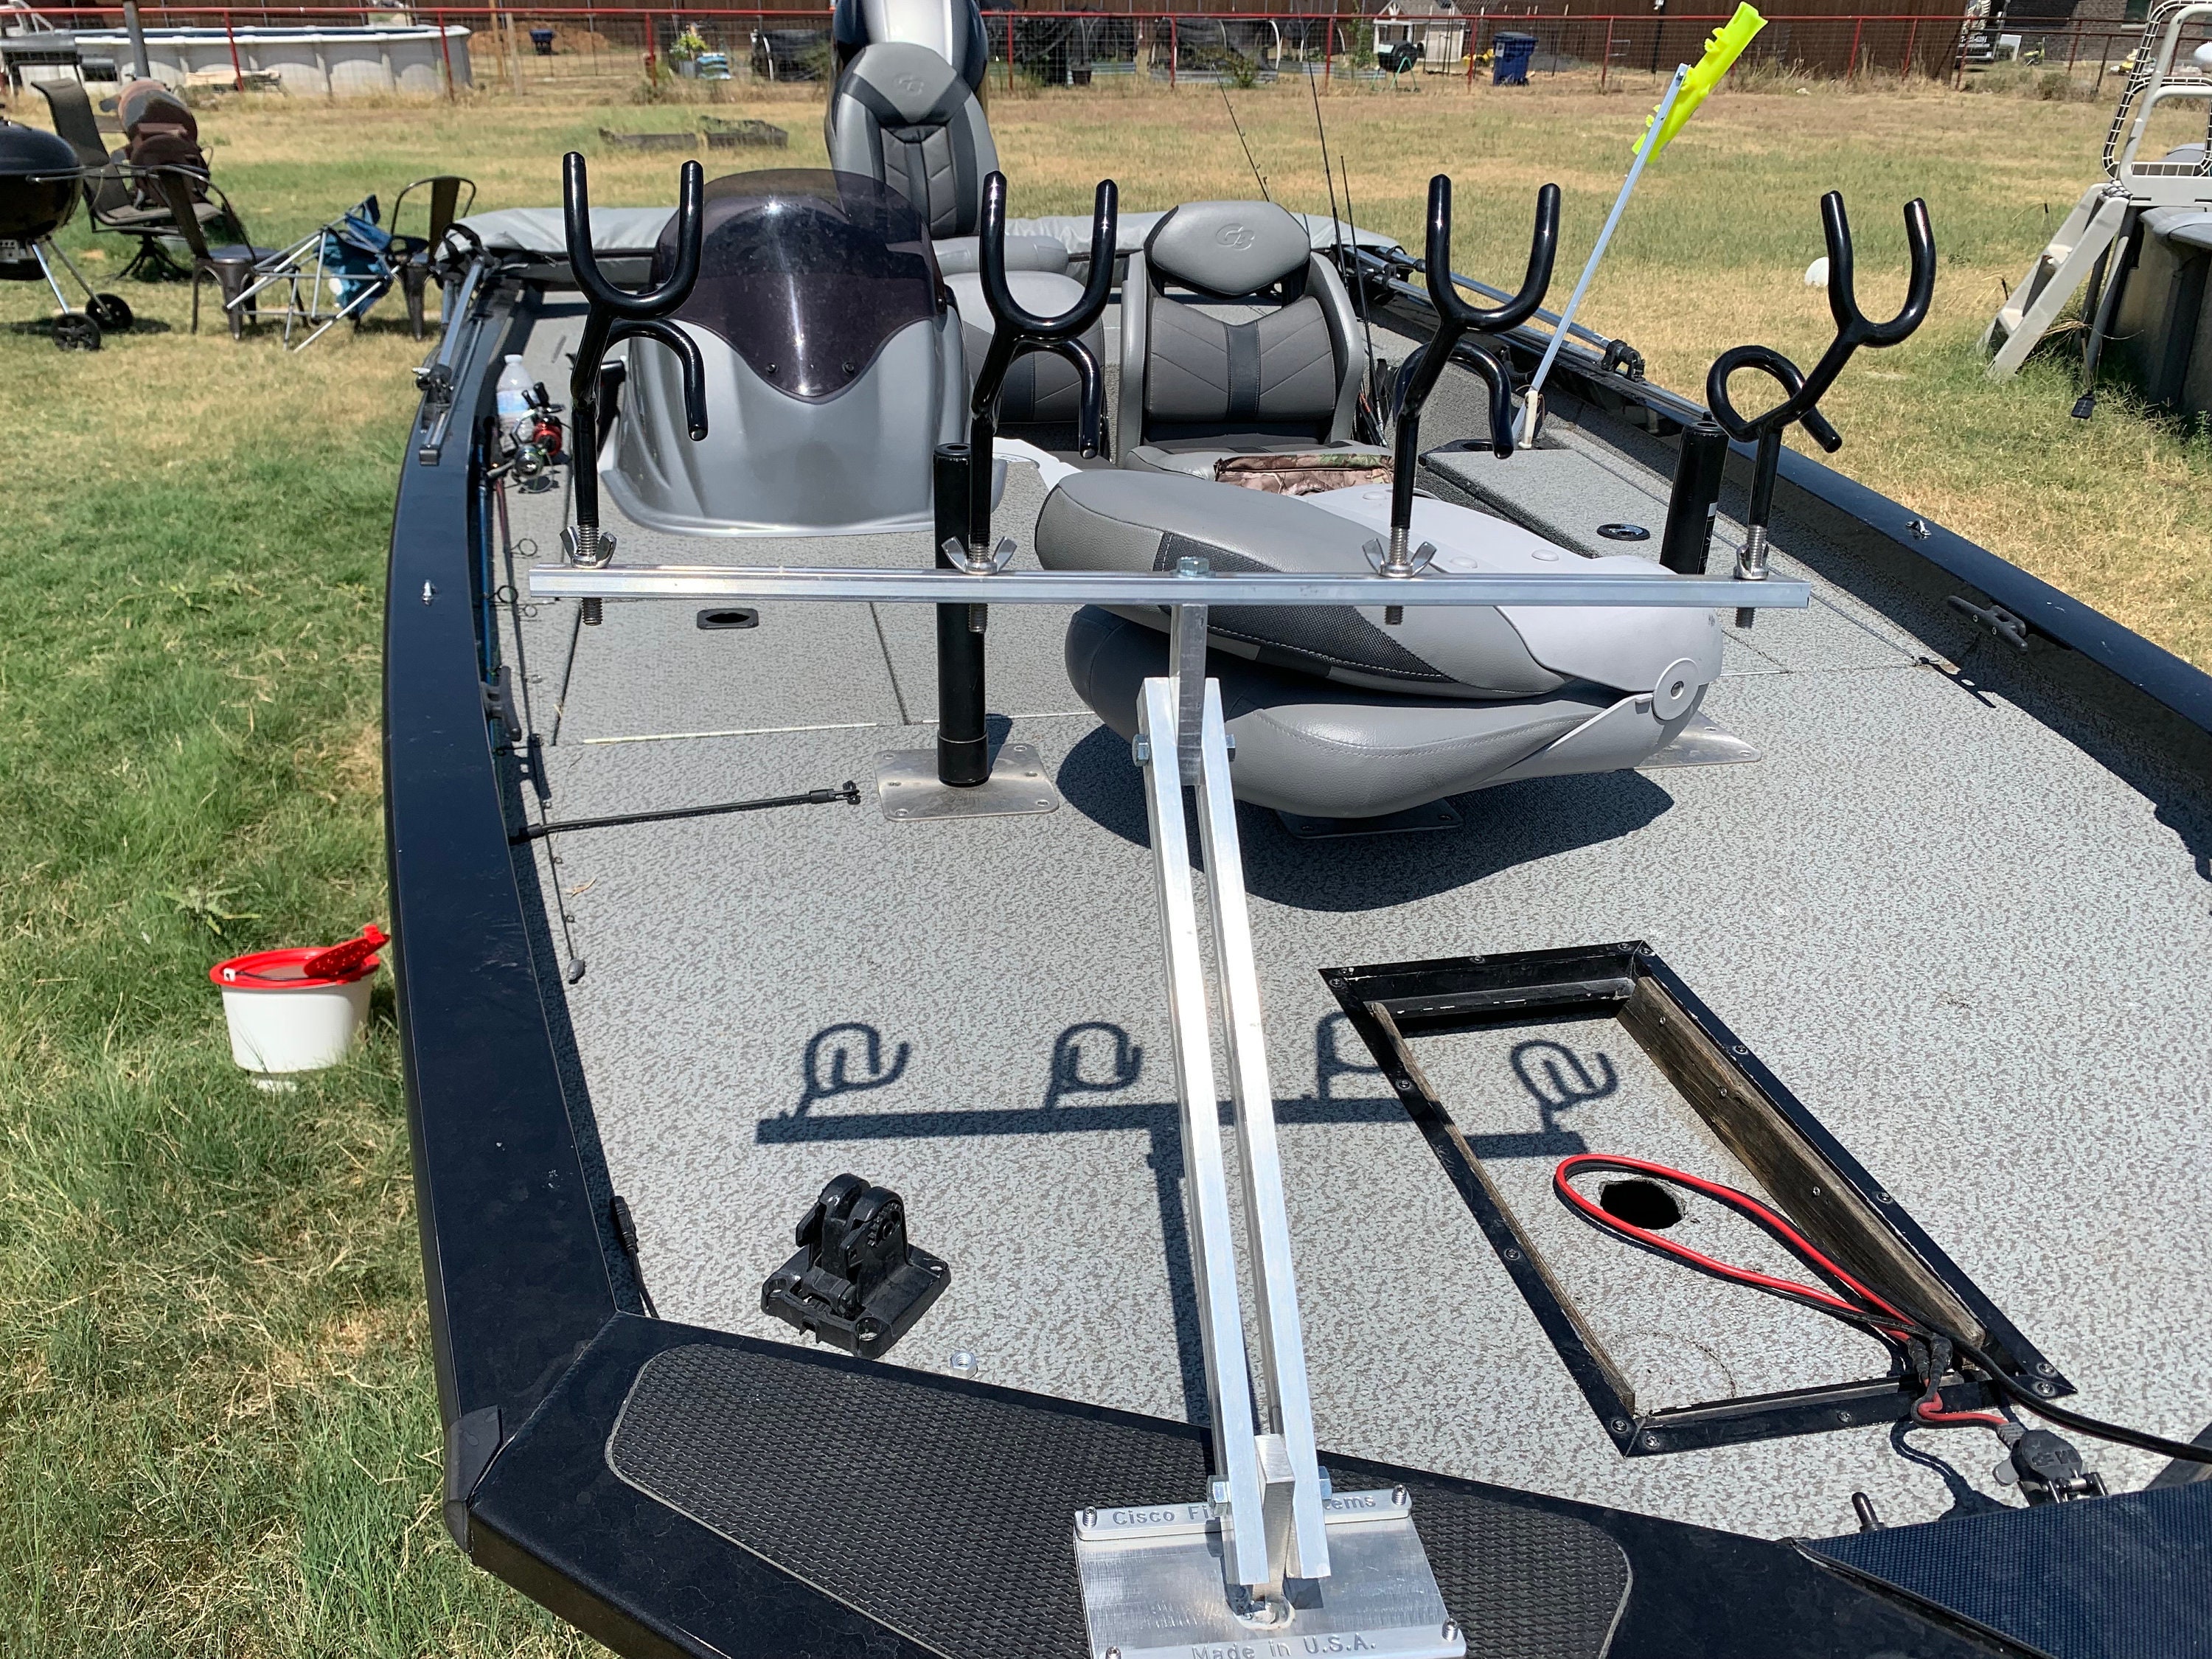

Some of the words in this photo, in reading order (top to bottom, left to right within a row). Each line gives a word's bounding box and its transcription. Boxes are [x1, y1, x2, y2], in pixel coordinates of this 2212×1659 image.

[1113, 1509, 1175, 1526] Cisco
[1192, 1642, 1255, 1659] Made
[1268, 1639, 1292, 1658] in
[1303, 1632, 1377, 1655] U.S.A.
